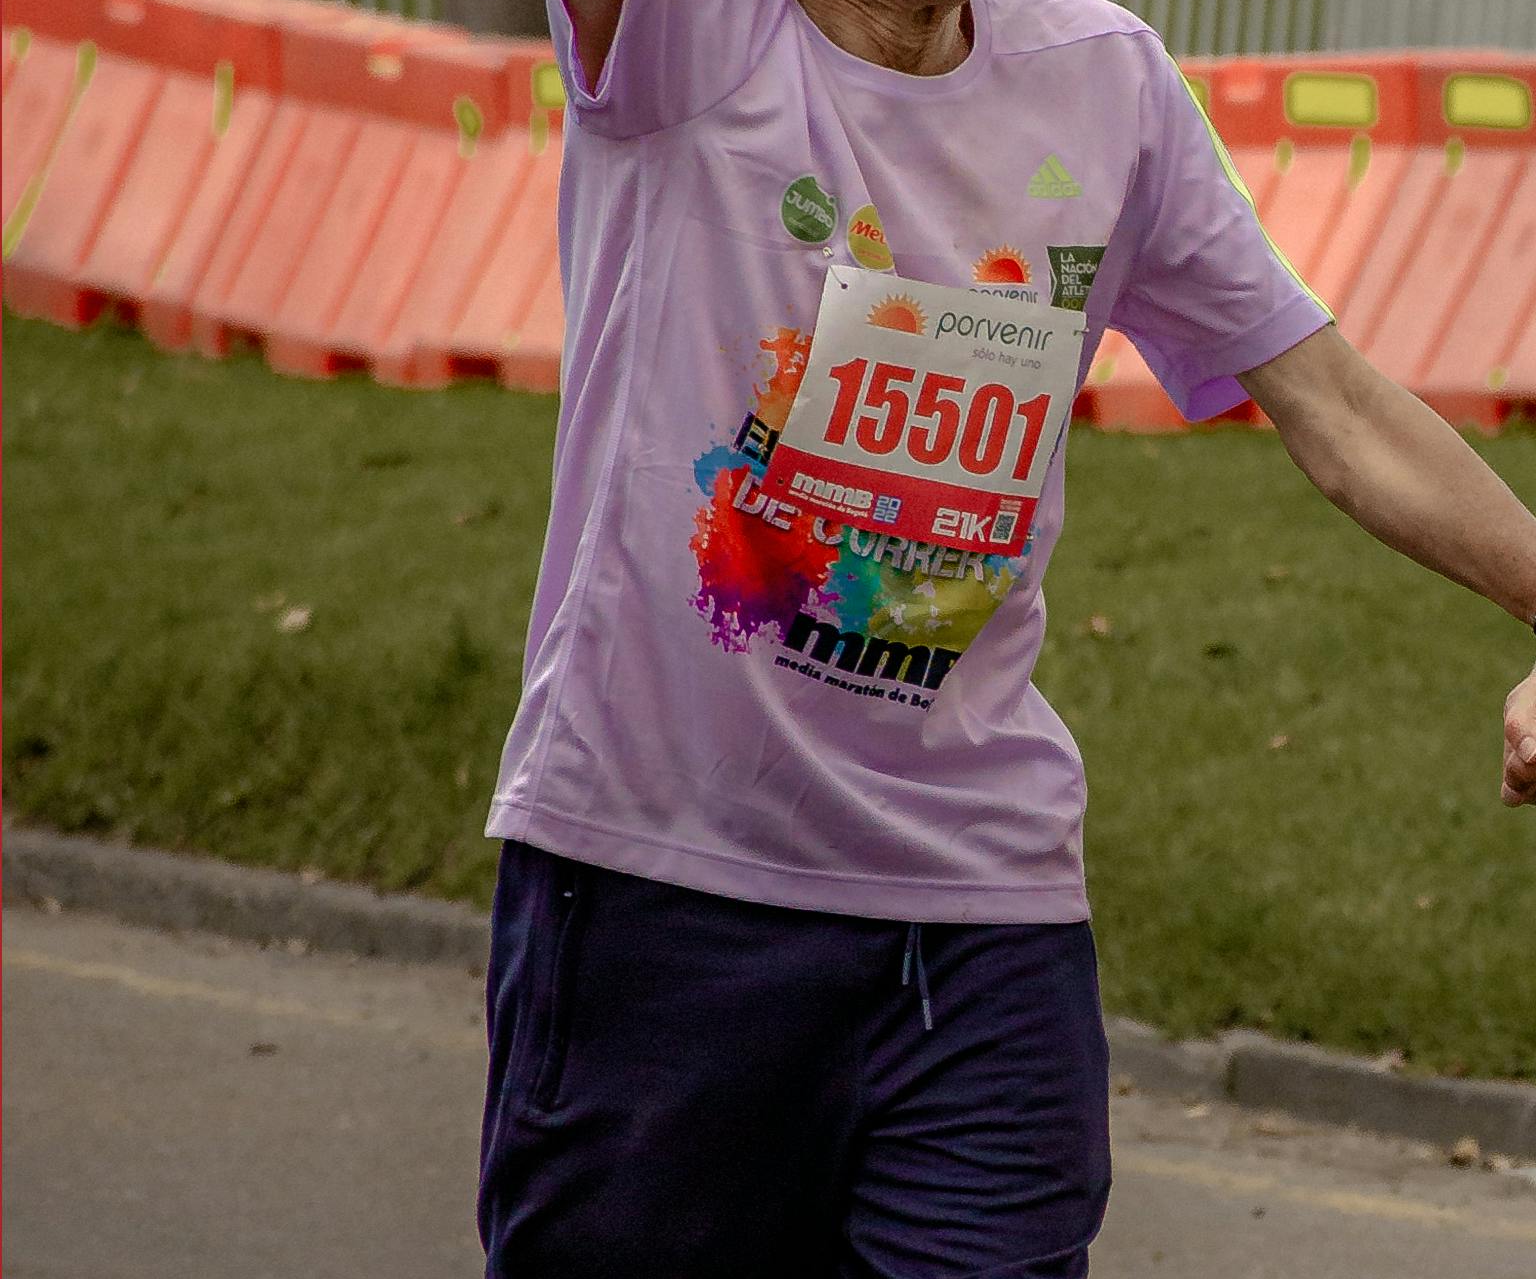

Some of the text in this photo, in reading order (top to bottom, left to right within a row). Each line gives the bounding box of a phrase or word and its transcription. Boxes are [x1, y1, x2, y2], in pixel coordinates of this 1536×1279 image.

[1060, 252, 1075, 263] LA
[1060, 274, 1082, 285] DEL
[935, 312, 1053, 351] porvenir
[972, 347, 1042, 370] sólo hay uno
[823, 357, 1052, 481] 15501
[931, 507, 992, 543] 21K
[774, 655, 822, 680] media
[823, 674, 886, 699] maratón
[887, 686, 908, 704] de
